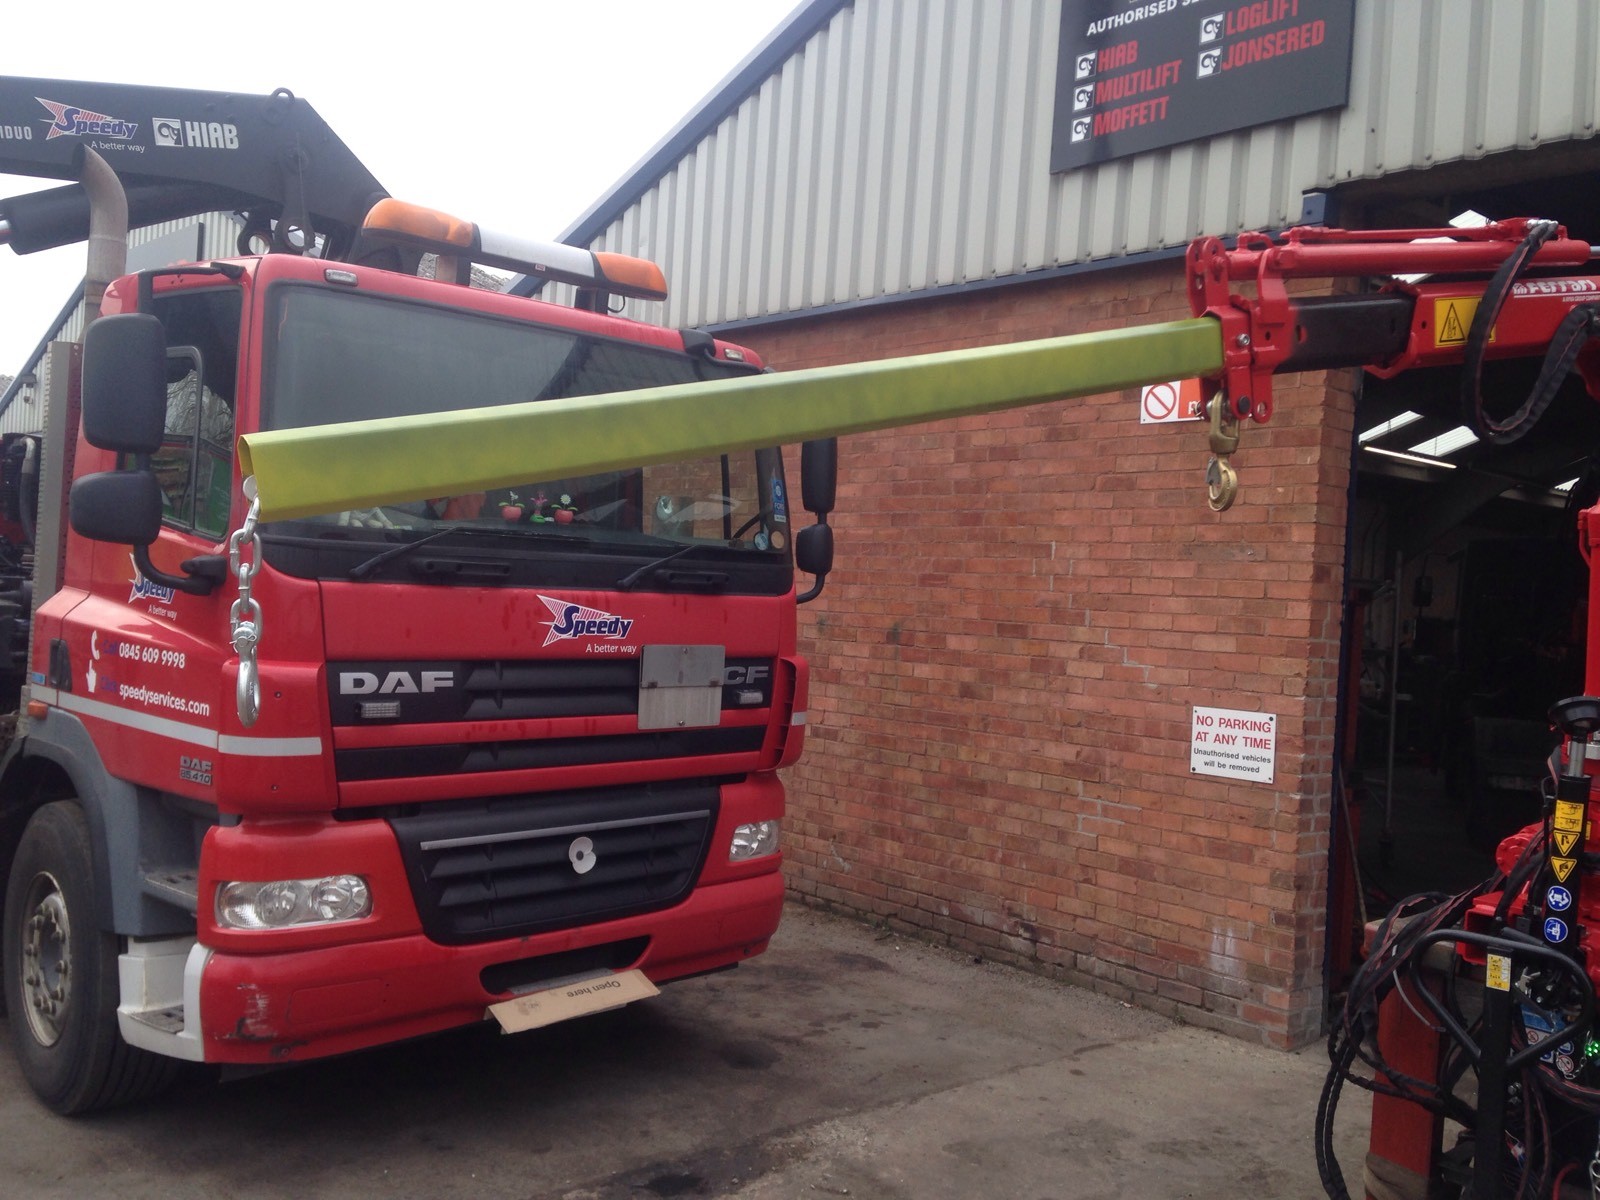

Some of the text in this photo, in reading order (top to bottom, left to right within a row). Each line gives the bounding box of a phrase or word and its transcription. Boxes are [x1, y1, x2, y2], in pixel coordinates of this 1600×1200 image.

[1087, 0, 1177, 36] AUTHORISED
[1226, 0, 1301, 35] LOGLIFT
[1098, 41, 1138, 72] HIAB
[1222, 20, 1325, 71] JONSERED
[1096, 59, 1182, 104] MULTILIFT
[54, 107, 137, 139] Speedy
[1094, 96, 1170, 136] MOFFETT
[100, 141, 125, 151] better
[127, 144, 145, 153] way
[185, 121, 239, 149] HIAB
[148, 605, 177, 621] A better way
[553, 605, 633, 638] Speedy
[119, 642, 140, 660] 0845
[142, 646, 160, 663] 609
[161, 650, 186, 669] 9998
[585, 643, 637, 655] A better way
[340, 671, 454, 695] DAF
[723, 665, 769, 685] CF
[119, 684, 210, 717] speedyservices.com
[1196, 715, 1272, 733] NO PARKING
[1195, 731, 1272, 750] AT ANY TIME
[180, 755, 212, 773] DAF
[1193, 747, 1271, 763] Unauthorised vehicles
[1203, 760, 1260, 773] will be removed
[566, 981, 621, 998] Open here
